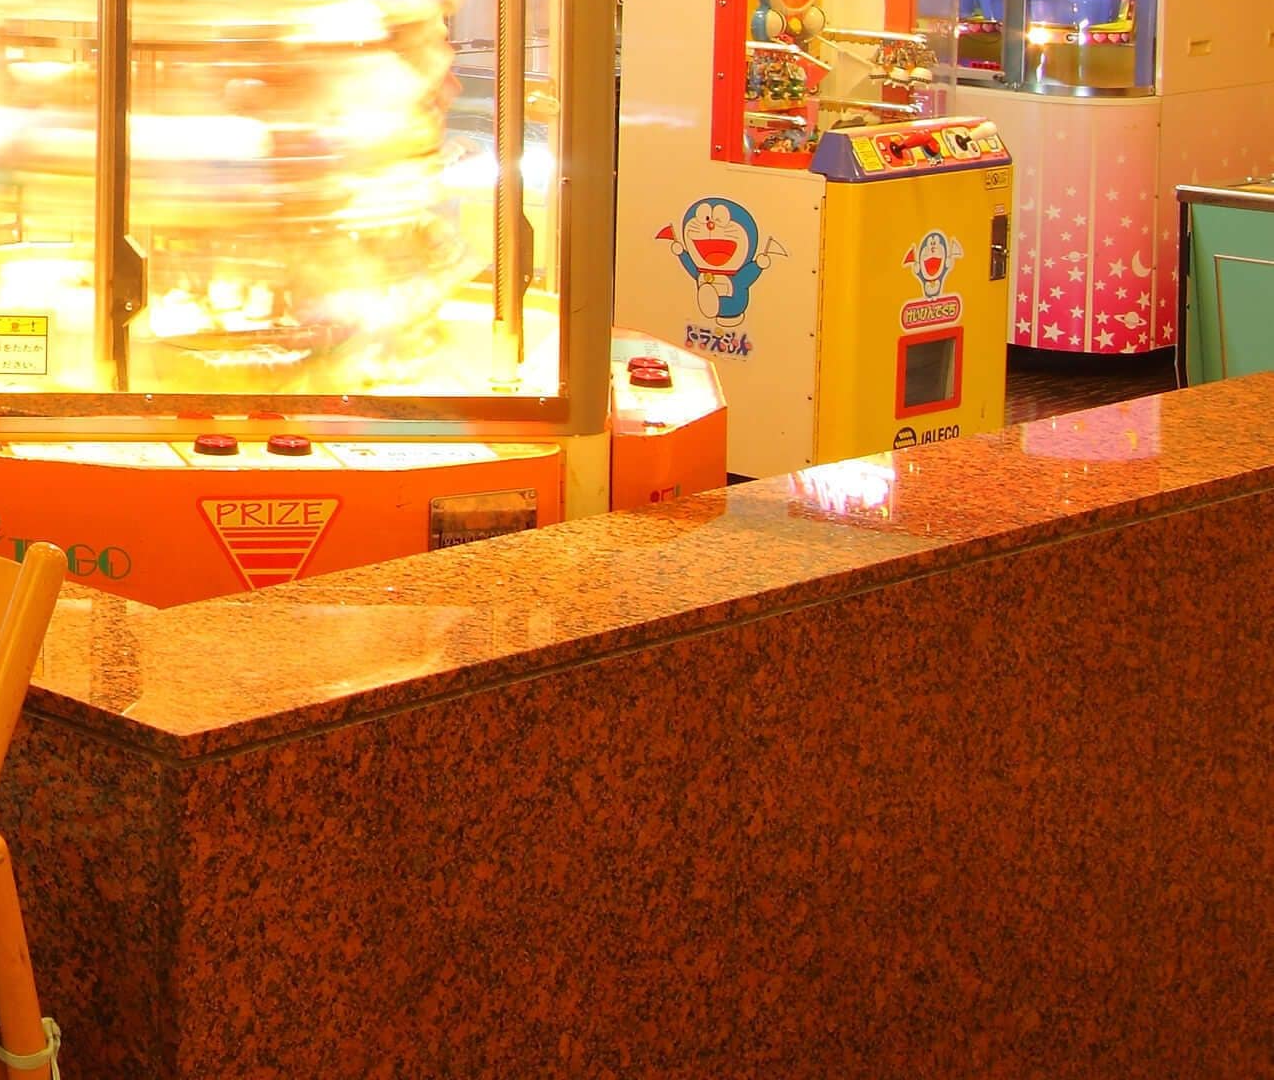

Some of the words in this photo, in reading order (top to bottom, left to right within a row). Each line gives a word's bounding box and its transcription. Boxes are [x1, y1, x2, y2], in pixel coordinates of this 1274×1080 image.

[684, 324, 753, 356] ドラえもん
[917, 424, 961, 446] JALECO
[215, 502, 325, 526] PRIZE
[9, 538, 132, 580] TGO
